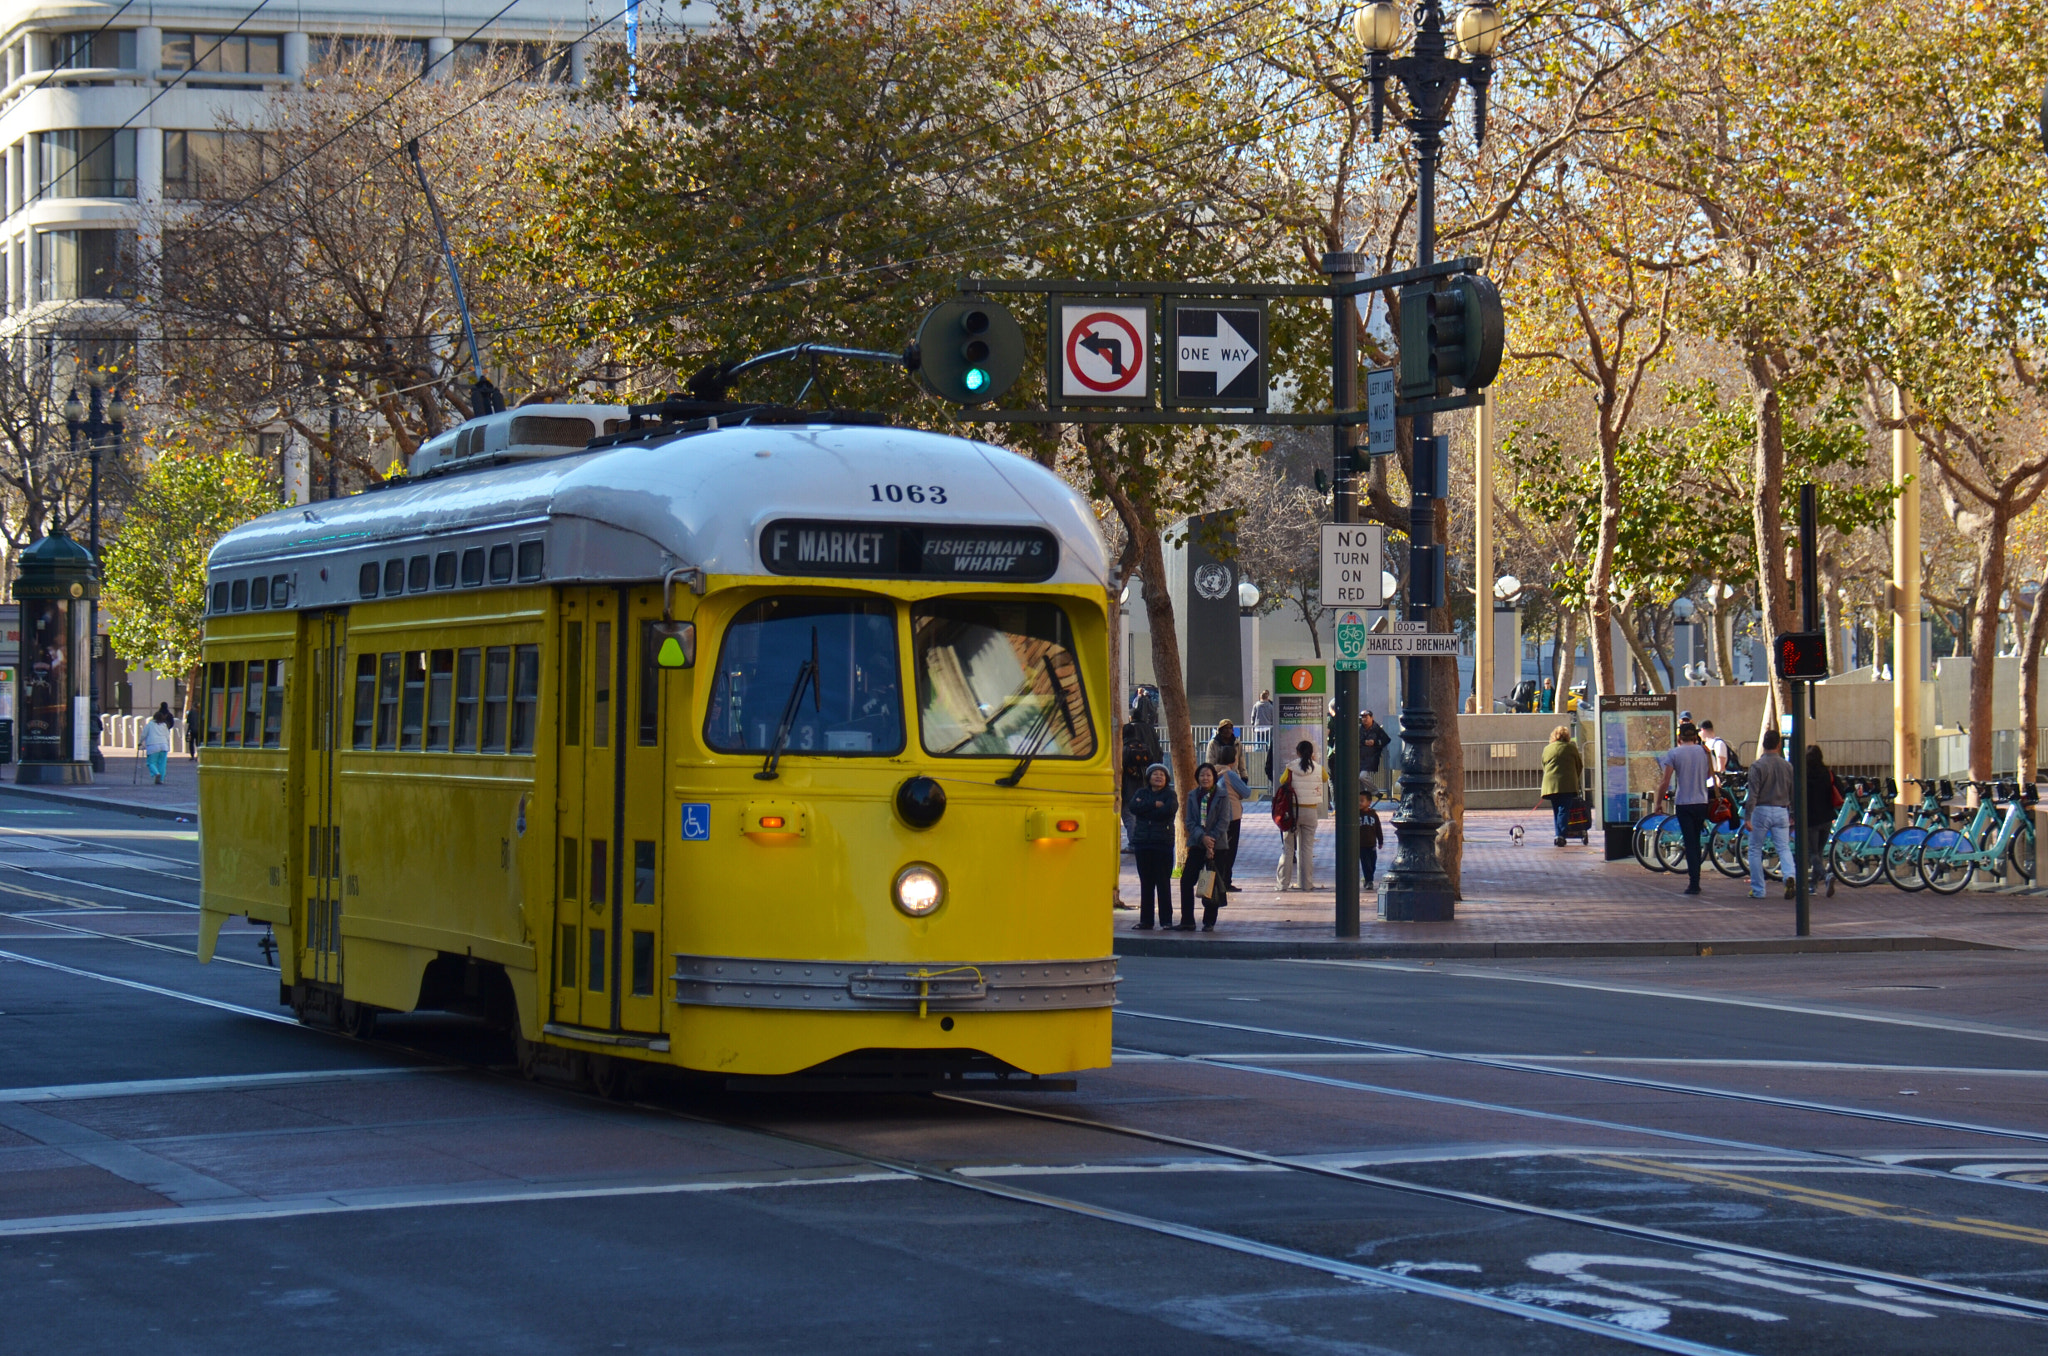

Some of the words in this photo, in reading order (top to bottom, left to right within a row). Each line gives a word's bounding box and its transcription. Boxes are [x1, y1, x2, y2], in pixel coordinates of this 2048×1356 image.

[1181, 347, 1210, 361] ONE
[1221, 348, 1249, 362] WAY
[1369, 382, 1380, 396] LEFT
[1381, 380, 1393, 394] LANE
[1374, 403, 1389, 421] MUST
[1370, 431, 1381, 444] TURN
[1383, 429, 1394, 443] LEFT
[869, 483, 948, 505] 1063
[1338, 531, 1367, 547] NO
[772, 529, 788, 561] F
[798, 531, 884, 565] MARKET
[922, 539, 1043, 557] FISHERMAN'S
[953, 556, 1016, 572] WHARF
[1333, 552, 1370, 565] TURN
[1341, 570, 1361, 582] ON
[1338, 588, 1365, 600] RED
[1343, 640, 1361, 654] 50
[1406, 638, 1413, 651] J
[1416, 638, 1457, 651] BRENHAM
[1342, 661, 1361, 669] WEST
